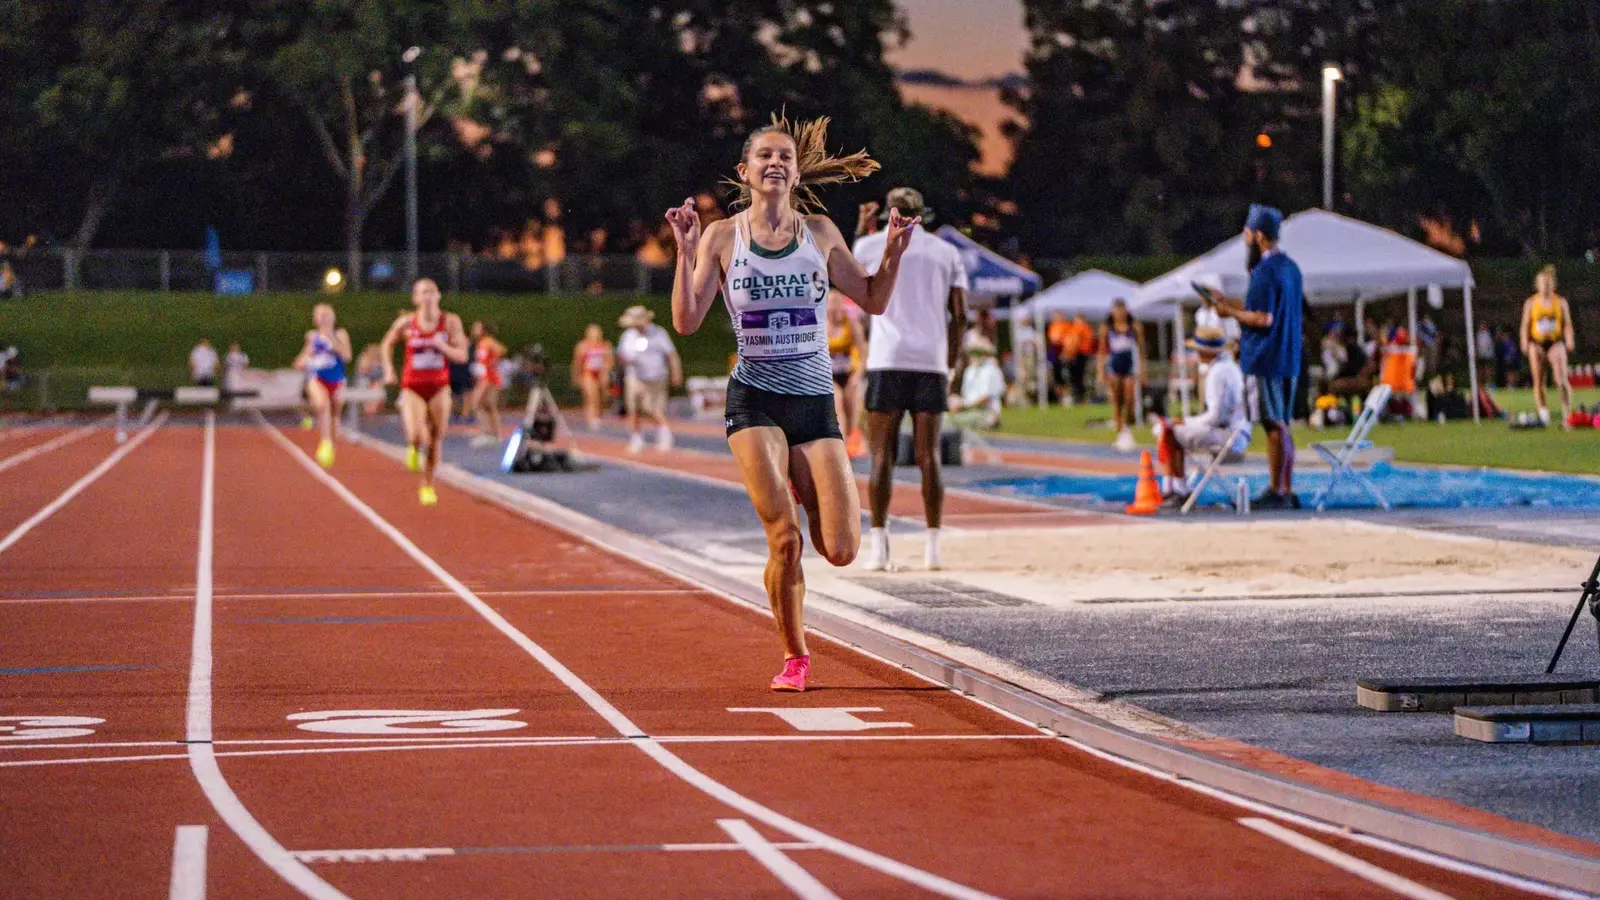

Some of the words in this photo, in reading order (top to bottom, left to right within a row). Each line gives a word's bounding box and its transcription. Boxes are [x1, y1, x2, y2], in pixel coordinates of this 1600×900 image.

[733, 273, 809, 290] COLORAD
[750, 286, 804, 301] STATE
[770, 316, 789, 327] 25
[745, 335, 773, 346] YASMIN
[775, 331, 816, 345] AUSTRIDGE
[286, 708, 528, 734] 2
[725, 706, 914, 731] 1
